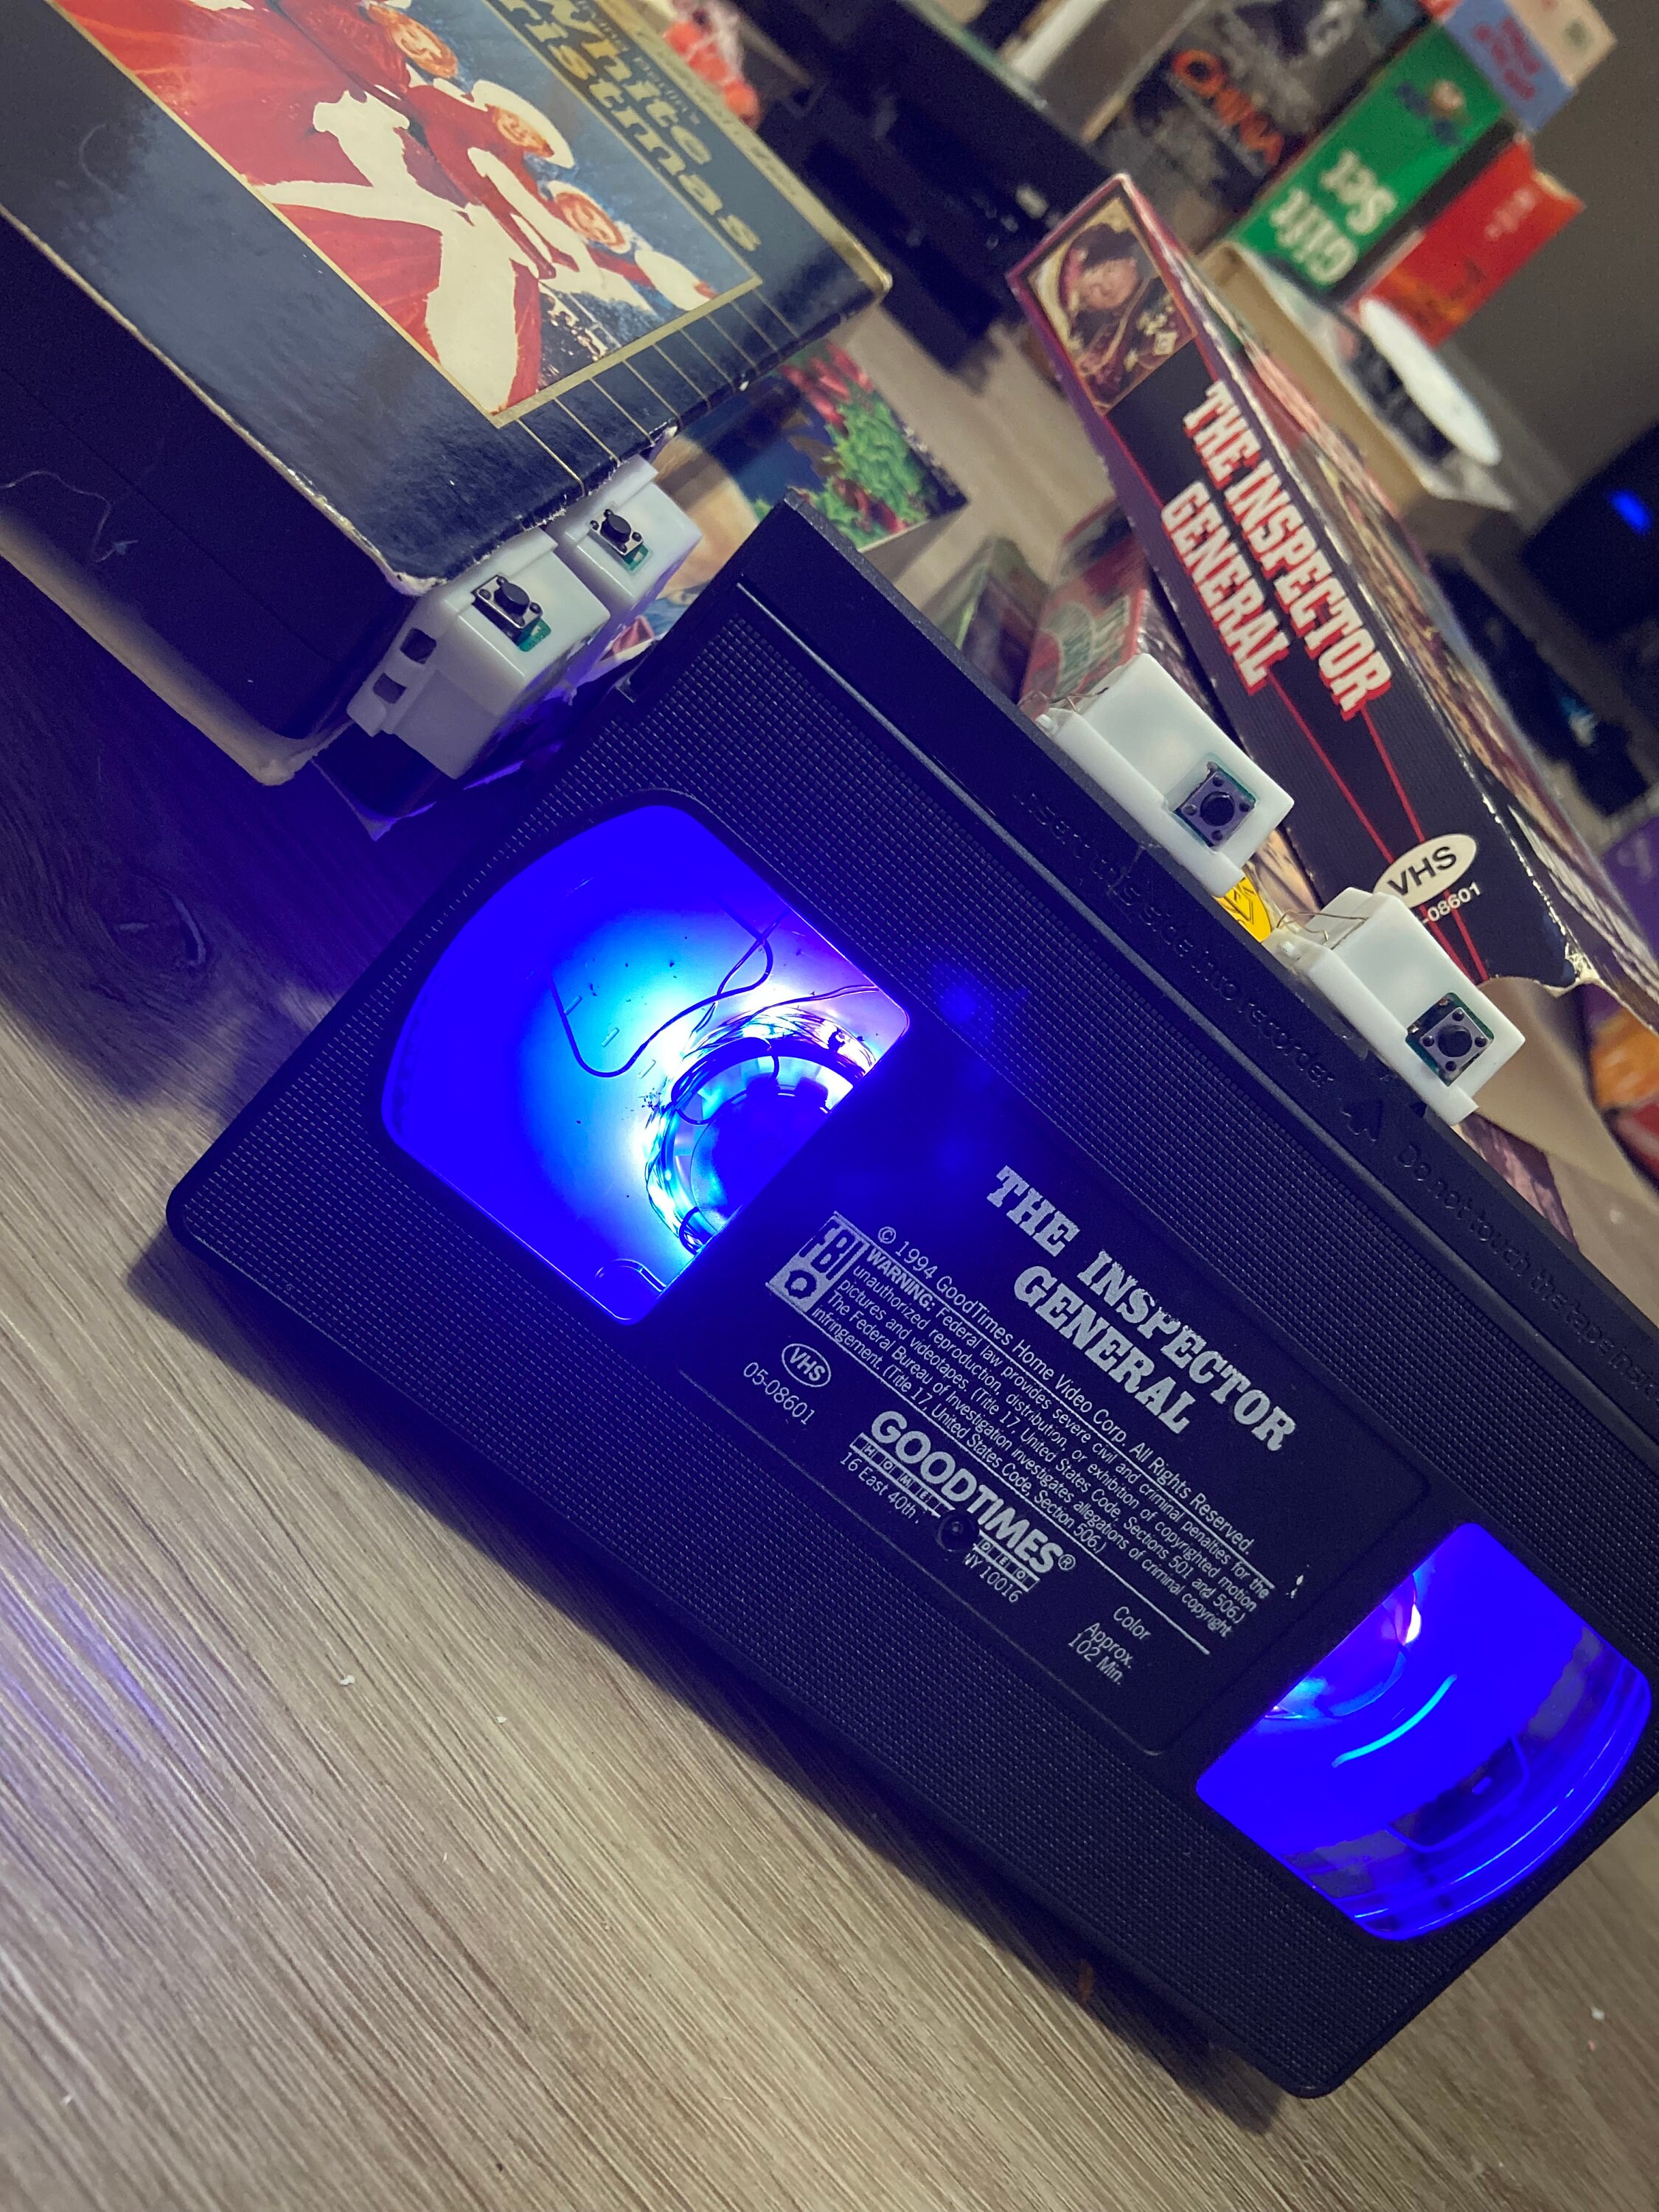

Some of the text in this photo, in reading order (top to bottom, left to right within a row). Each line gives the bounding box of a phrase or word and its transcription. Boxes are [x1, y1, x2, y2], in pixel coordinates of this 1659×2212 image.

[1161, 481, 1290, 695] GENERAL
[1183, 380, 1392, 721] THE INSPECTOR
[1387, 846, 1457, 896] VHS
[1422, 881, 1481, 924] -08601
[796, 1216, 865, 1283] FBI
[986, 1164, 1296, 1451] THE INSPECTOR
[743, 1362, 815, 1425] 05-08601
[790, 1343, 826, 1382] VHS
[866, 1248, 1272, 1599] WARNING: Federal law provides severe civil and criminal penalties for the
[894, 1241, 938, 1279] 1994
[936, 1276, 1014, 1346] GoodTimes
[1012, 1339, 1054, 1380] Home
[1054, 1374, 1093, 1413] Video
[1093, 1408, 1127, 1447] Corp.
[1128, 1442, 1154, 1463] All
[1147, 1456, 1192, 1499] Rights
[1189, 1492, 1255, 1555] Reserved.
[1014, 1265, 1196, 1434] GENERAL
[811, 1307, 1107, 1554] infringement. (Title 17, United States Code, Section 506.)
[827, 1290, 1232, 1638] The Federal Bureau of Investigation investigates allegations of criminal copyright
[837, 1279, 1246, 1624] pictures and videotapes. (Title 17, United States Code, Sections 501 and 506.)
[852, 1265, 1257, 1613] unauthorized reproduction, distribution, or exhibition of copyrighted motion
[840, 1452, 863, 1472] 16
[858, 1466, 889, 1496] East
[887, 1492, 917, 1519] 40th
[979, 1565, 1023, 1603] 10016
[861, 1442, 1027, 1582] HOME DEO
[1068, 1632, 1123, 1686] 102 Min.
[1084, 1622, 1133, 1669] Approx.
[1113, 1606, 1151, 1640] Color
